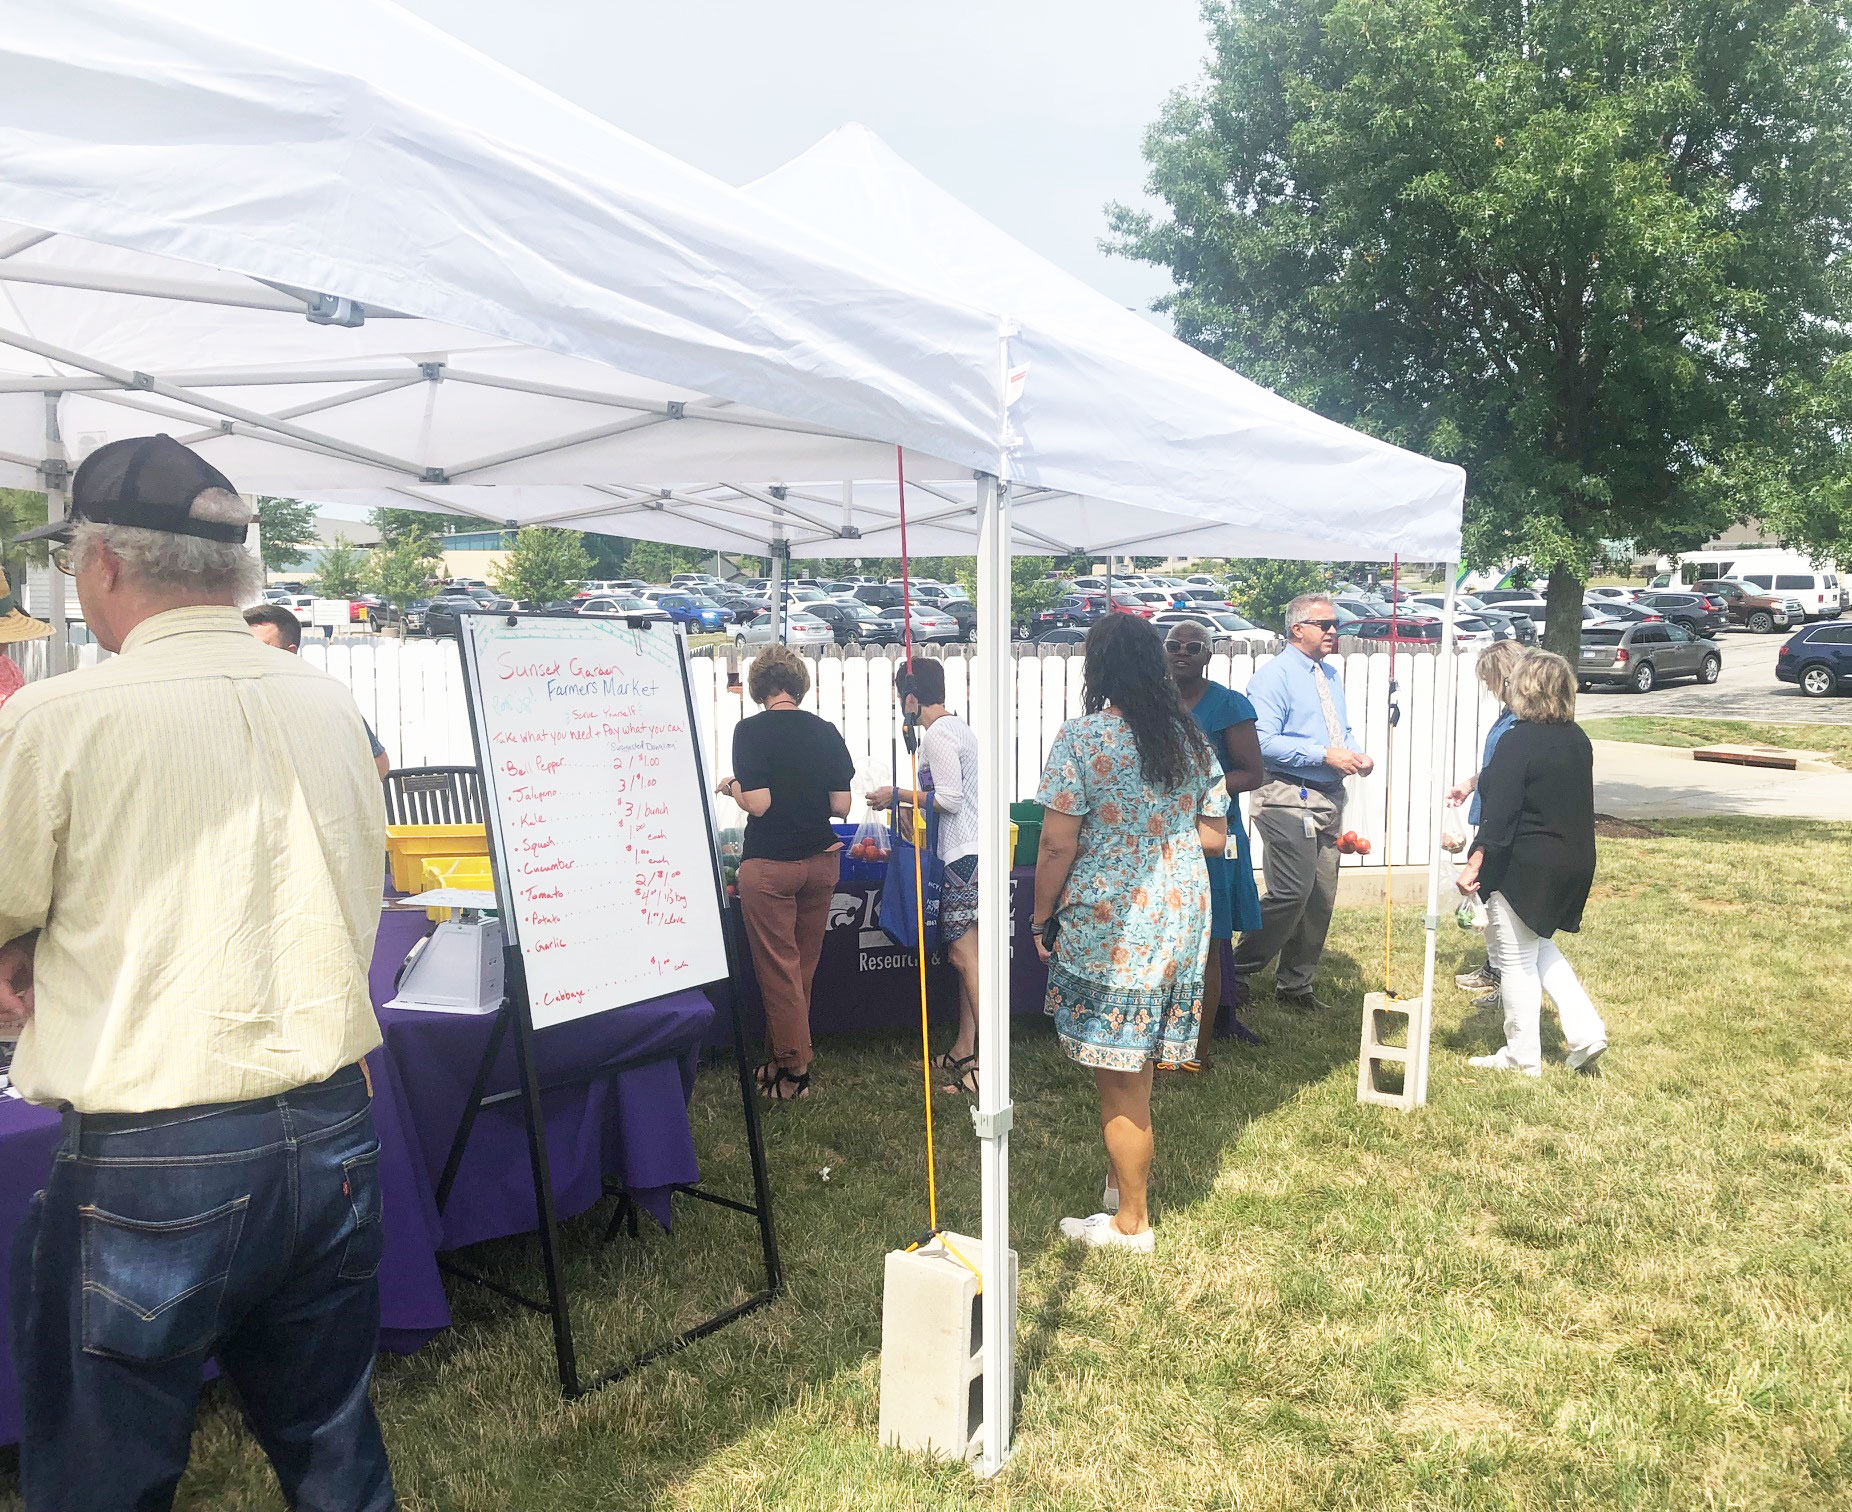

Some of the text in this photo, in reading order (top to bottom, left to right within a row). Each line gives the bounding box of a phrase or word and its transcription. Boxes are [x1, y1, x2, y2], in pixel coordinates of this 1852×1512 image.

[497, 652, 625, 680] Sunset Garden
[547, 677, 660, 702] Farmers Market
[572, 704, 637, 720] Serve Yourself
[493, 731, 518, 744] Take
[551, 729, 567, 747] you
[570, 725, 593, 740] need
[602, 723, 620, 743] Pay
[621, 721, 647, 735] what
[649, 724, 665, 739] you
[506, 760, 533, 777] Bell
[536, 755, 565, 775] Pepper
[520, 812, 547, 829] Kale
[522, 835, 556, 858] Squash
[648, 828, 667, 841] each
[523, 857, 576, 875] Cucumber
[648, 855, 670, 866] each
[525, 885, 564, 902] Tomato
[532, 910, 561, 926] Potato
[535, 936, 567, 953] Garlic
[860, 951, 918, 971] Researc
[543, 987, 586, 1005] Cabbage
